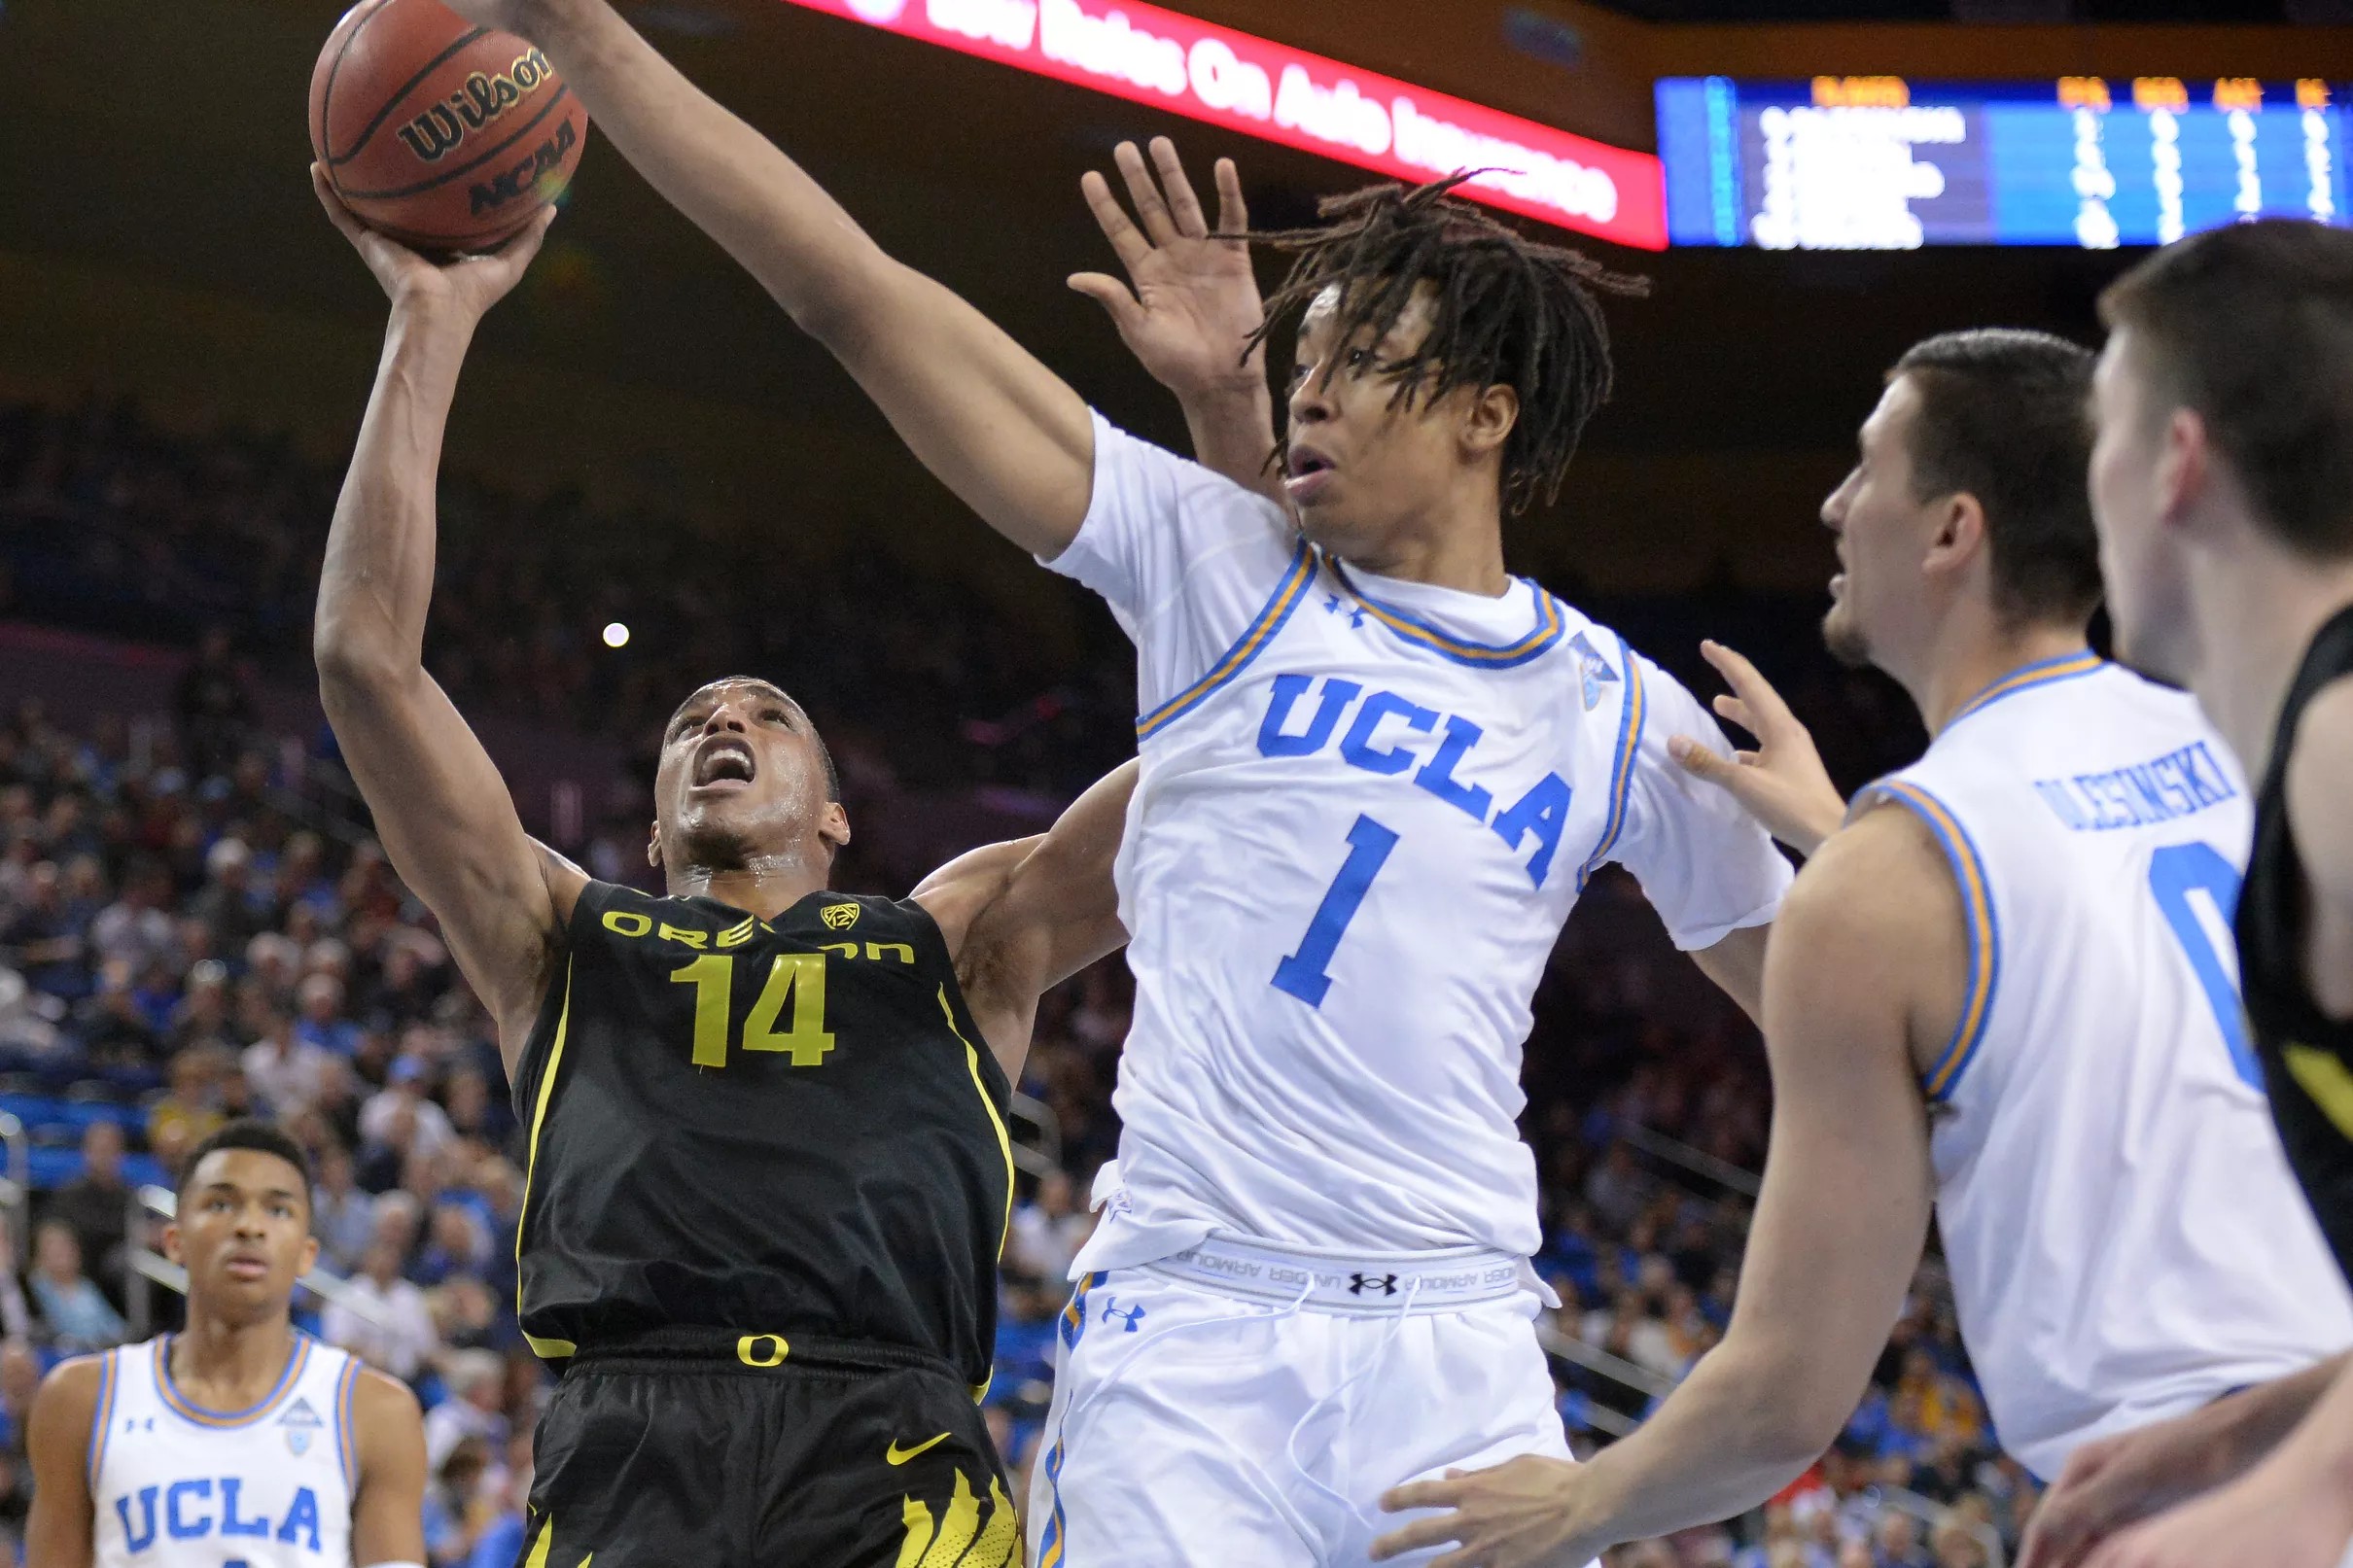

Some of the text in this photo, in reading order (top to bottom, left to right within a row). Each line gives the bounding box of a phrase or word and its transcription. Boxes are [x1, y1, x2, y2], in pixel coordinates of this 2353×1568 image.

[396, 47, 553, 163] Wilson
[1188, 40, 1271, 118] On
[1275, 67, 1391, 154] Auto
[469, 118, 577, 215] NCAA
[1256, 674, 1572, 891] UCLA
[832, 915, 850, 926] 12
[1270, 814, 1400, 1009] 1
[670, 954, 835, 1068] 14
[116, 1478, 321, 1554] UCLA
